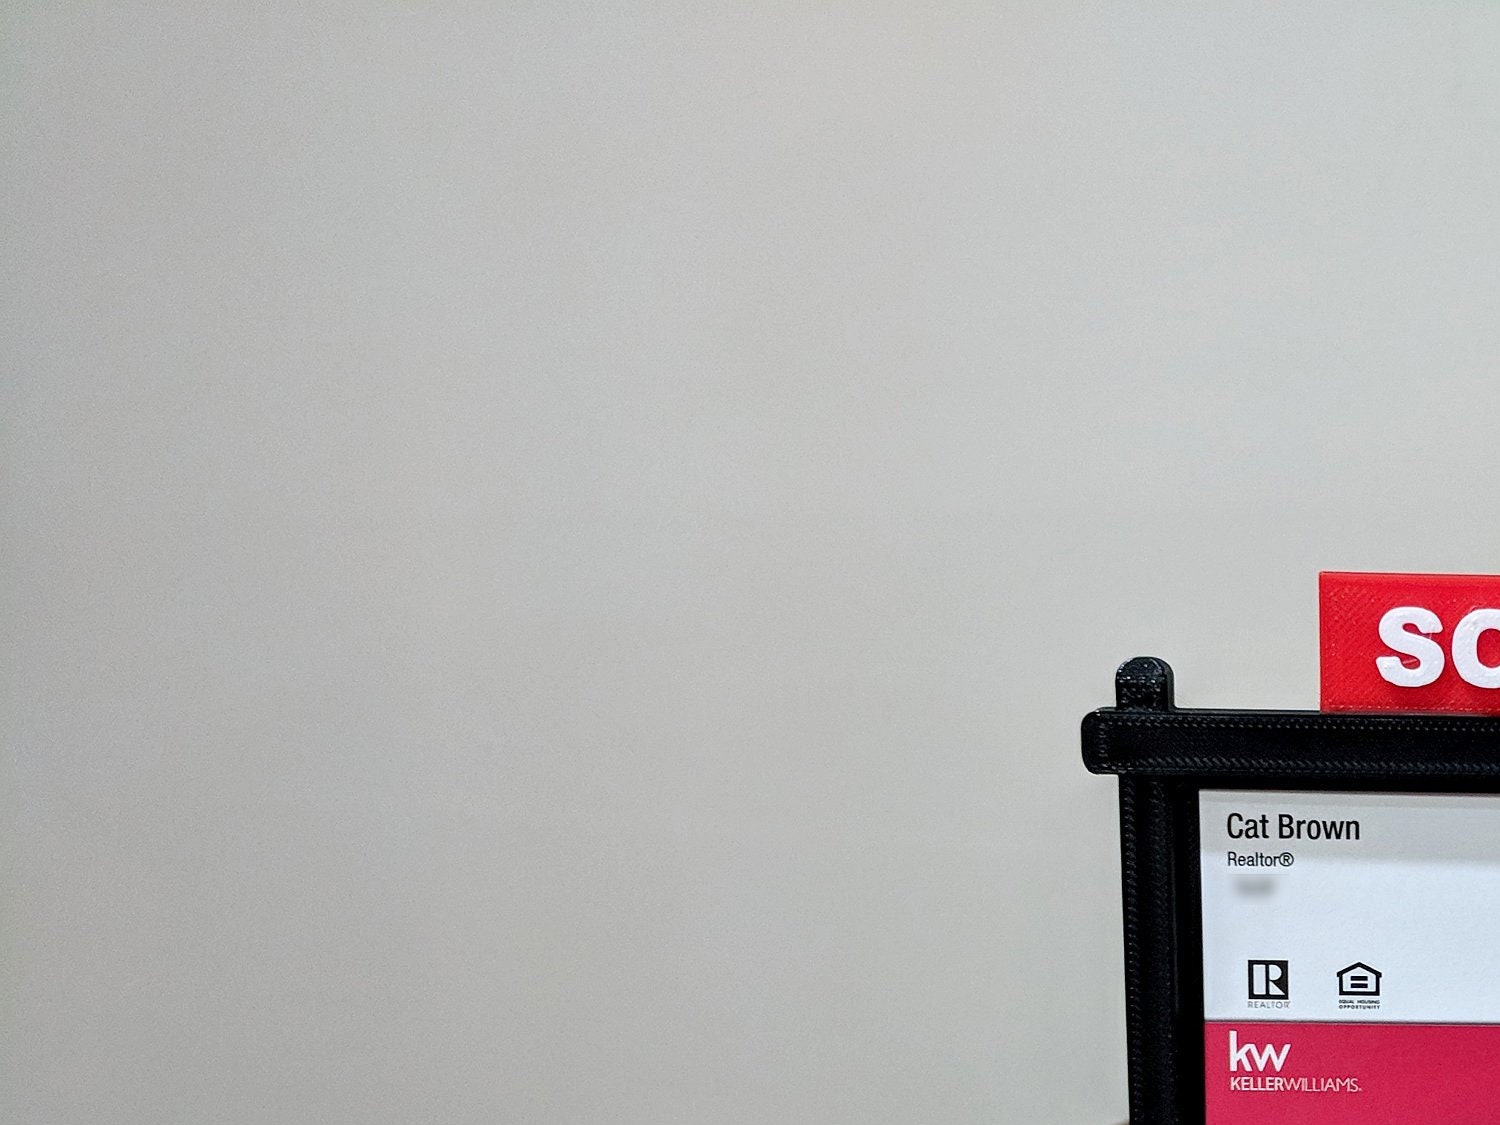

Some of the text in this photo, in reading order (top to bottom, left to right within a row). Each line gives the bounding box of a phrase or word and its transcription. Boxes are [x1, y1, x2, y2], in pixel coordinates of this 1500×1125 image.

[1227, 812, 1361, 840] Cat Brown
[1229, 1030, 1292, 1072] kw
